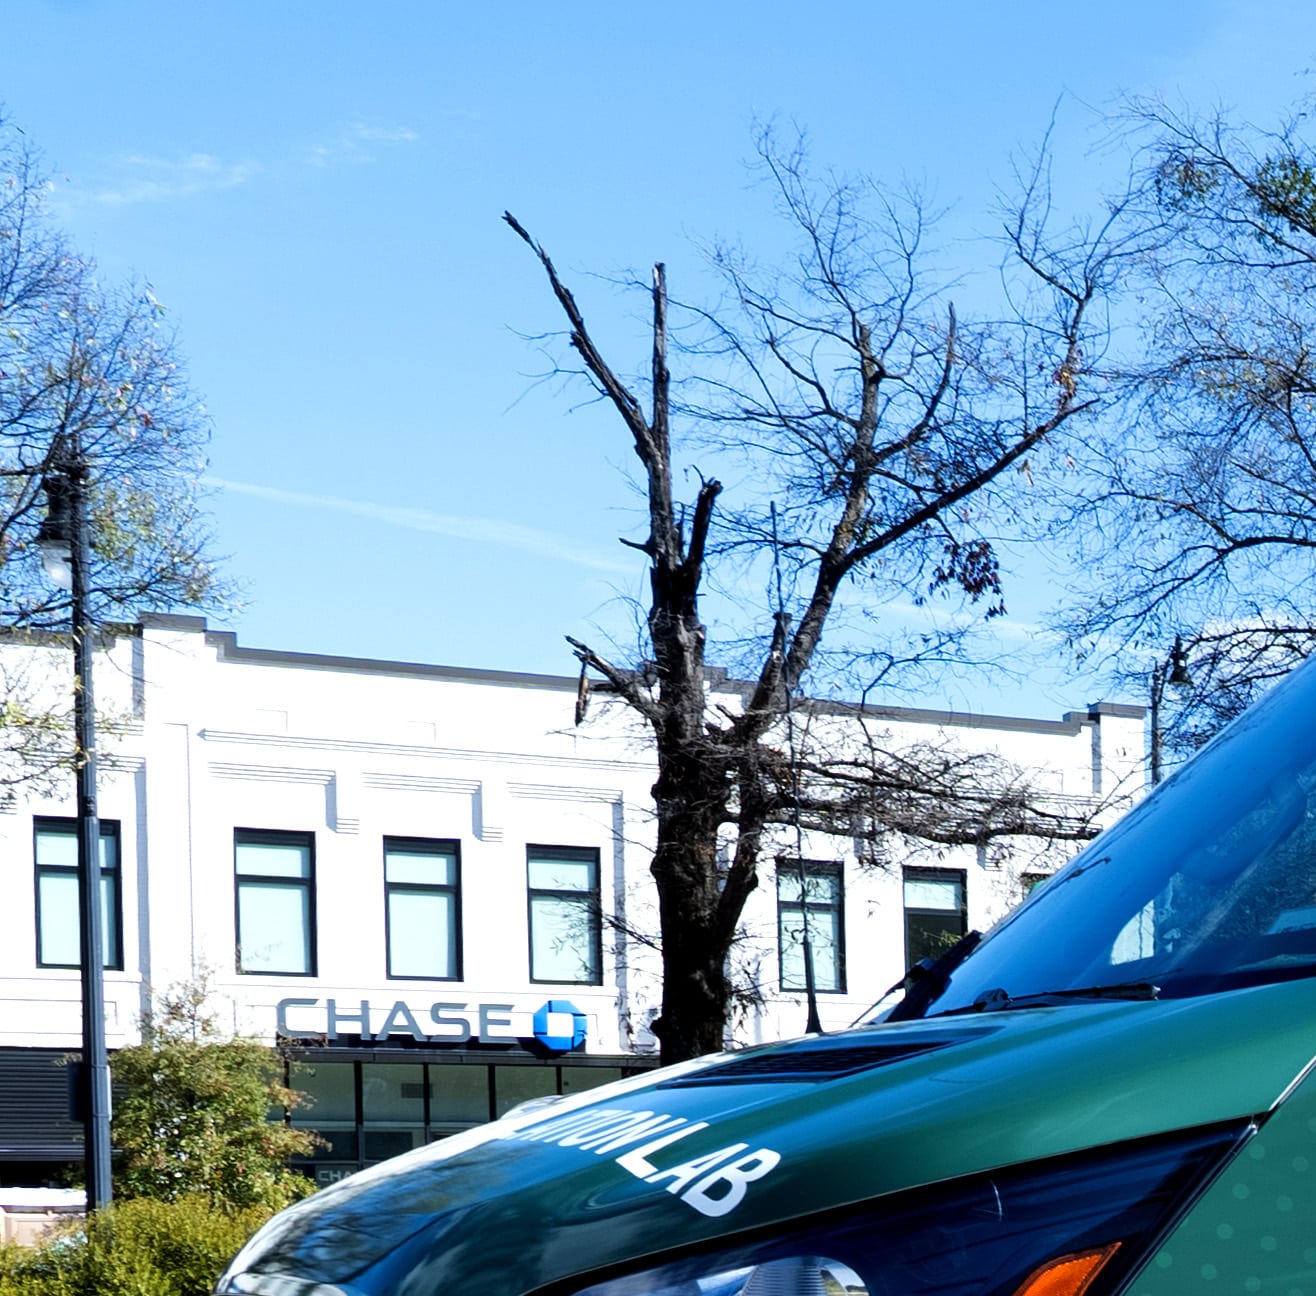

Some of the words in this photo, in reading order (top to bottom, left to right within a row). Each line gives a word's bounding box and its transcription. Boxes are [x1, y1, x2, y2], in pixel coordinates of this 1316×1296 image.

[276, 997, 517, 1044] CHASE
[318, 1170, 352, 1182] CHA
[615, 1121, 782, 1218] LAB
